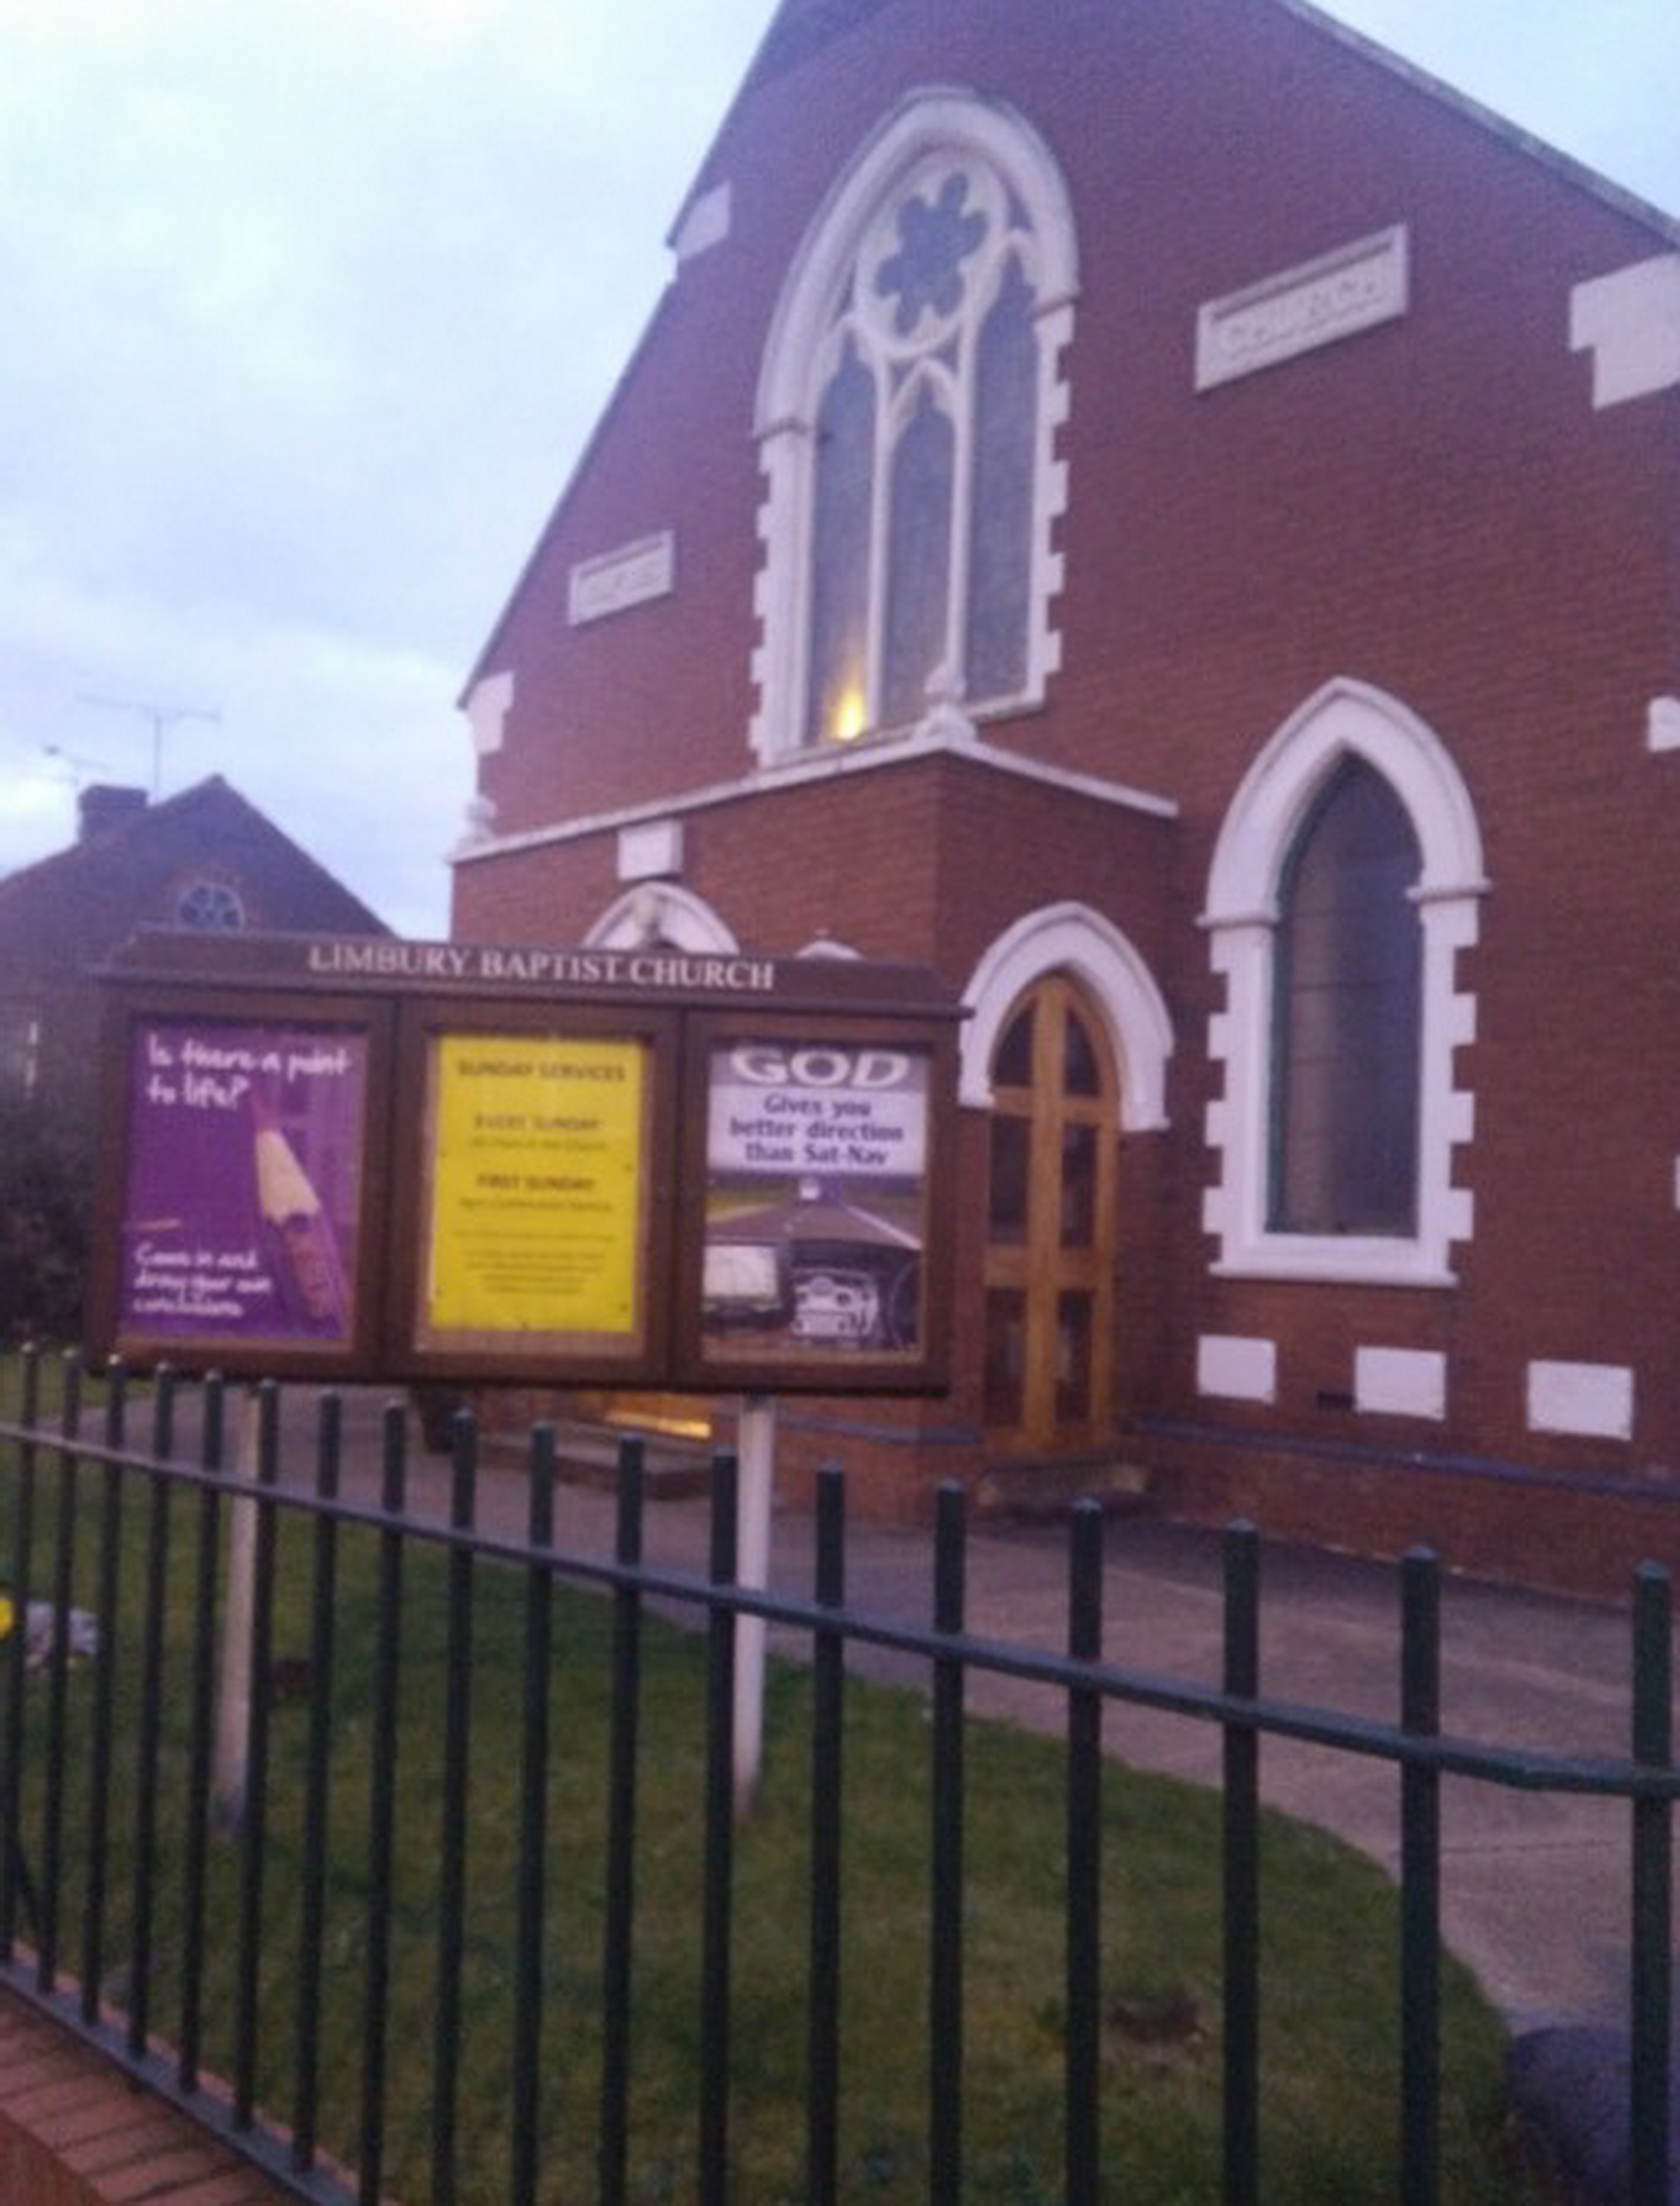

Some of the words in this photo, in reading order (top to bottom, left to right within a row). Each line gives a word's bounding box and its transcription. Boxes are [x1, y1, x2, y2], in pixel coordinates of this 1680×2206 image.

[308, 944, 468, 976] LIMBURY
[479, 952, 619, 983] BAPTIST
[628, 956, 776, 991] CHURCH
[149, 1033, 173, 1066] Is
[181, 1038, 255, 1070] there
[262, 1052, 281, 1072] a
[288, 1049, 349, 1084] point
[457, 1060, 533, 1076] SUNDAY
[730, 1046, 910, 1089] GOD
[148, 1075, 176, 1104] to
[184, 1072, 249, 1109] life?
[764, 1094, 823, 1115] Gives
[833, 1101, 871, 1118] you
[730, 1117, 795, 1136] better
[805, 1122, 904, 1141] direction
[195, 1250, 213, 1267] in
[218, 1249, 258, 1270] and
